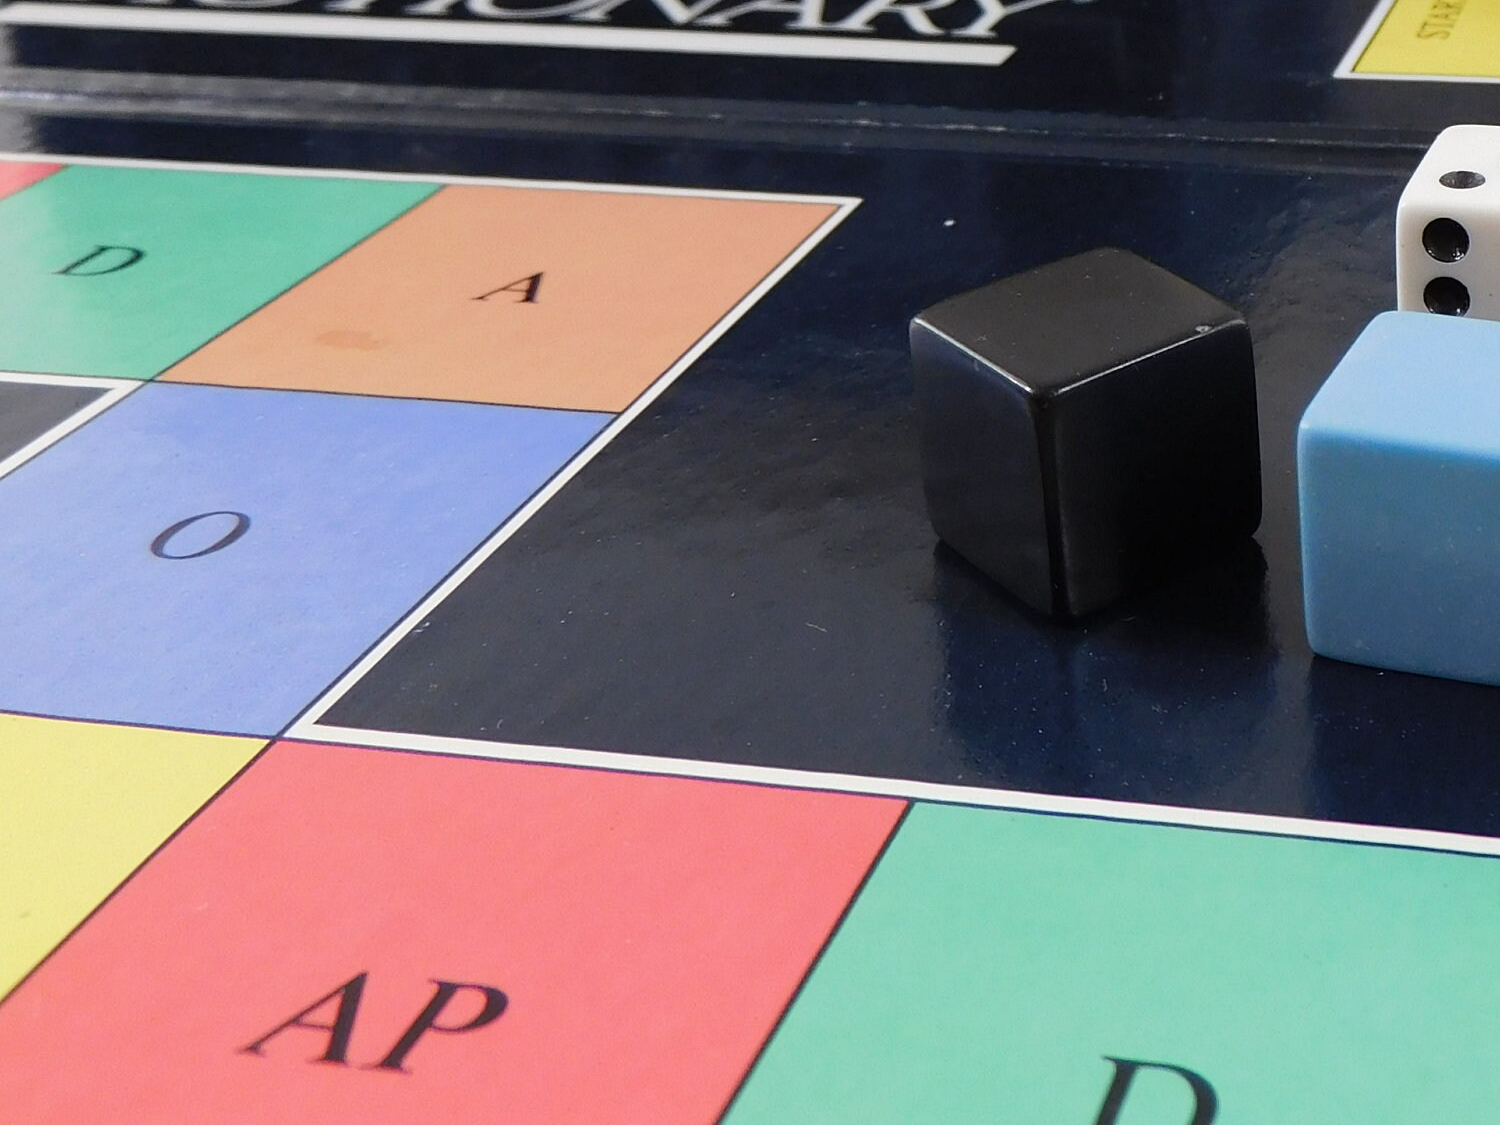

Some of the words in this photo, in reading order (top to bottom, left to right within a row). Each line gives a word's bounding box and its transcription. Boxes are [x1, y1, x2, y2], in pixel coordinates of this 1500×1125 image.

[51, 245, 146, 277] D
[470, 271, 545, 304] A
[150, 510, 252, 561] O
[235, 968, 511, 1075] AP
